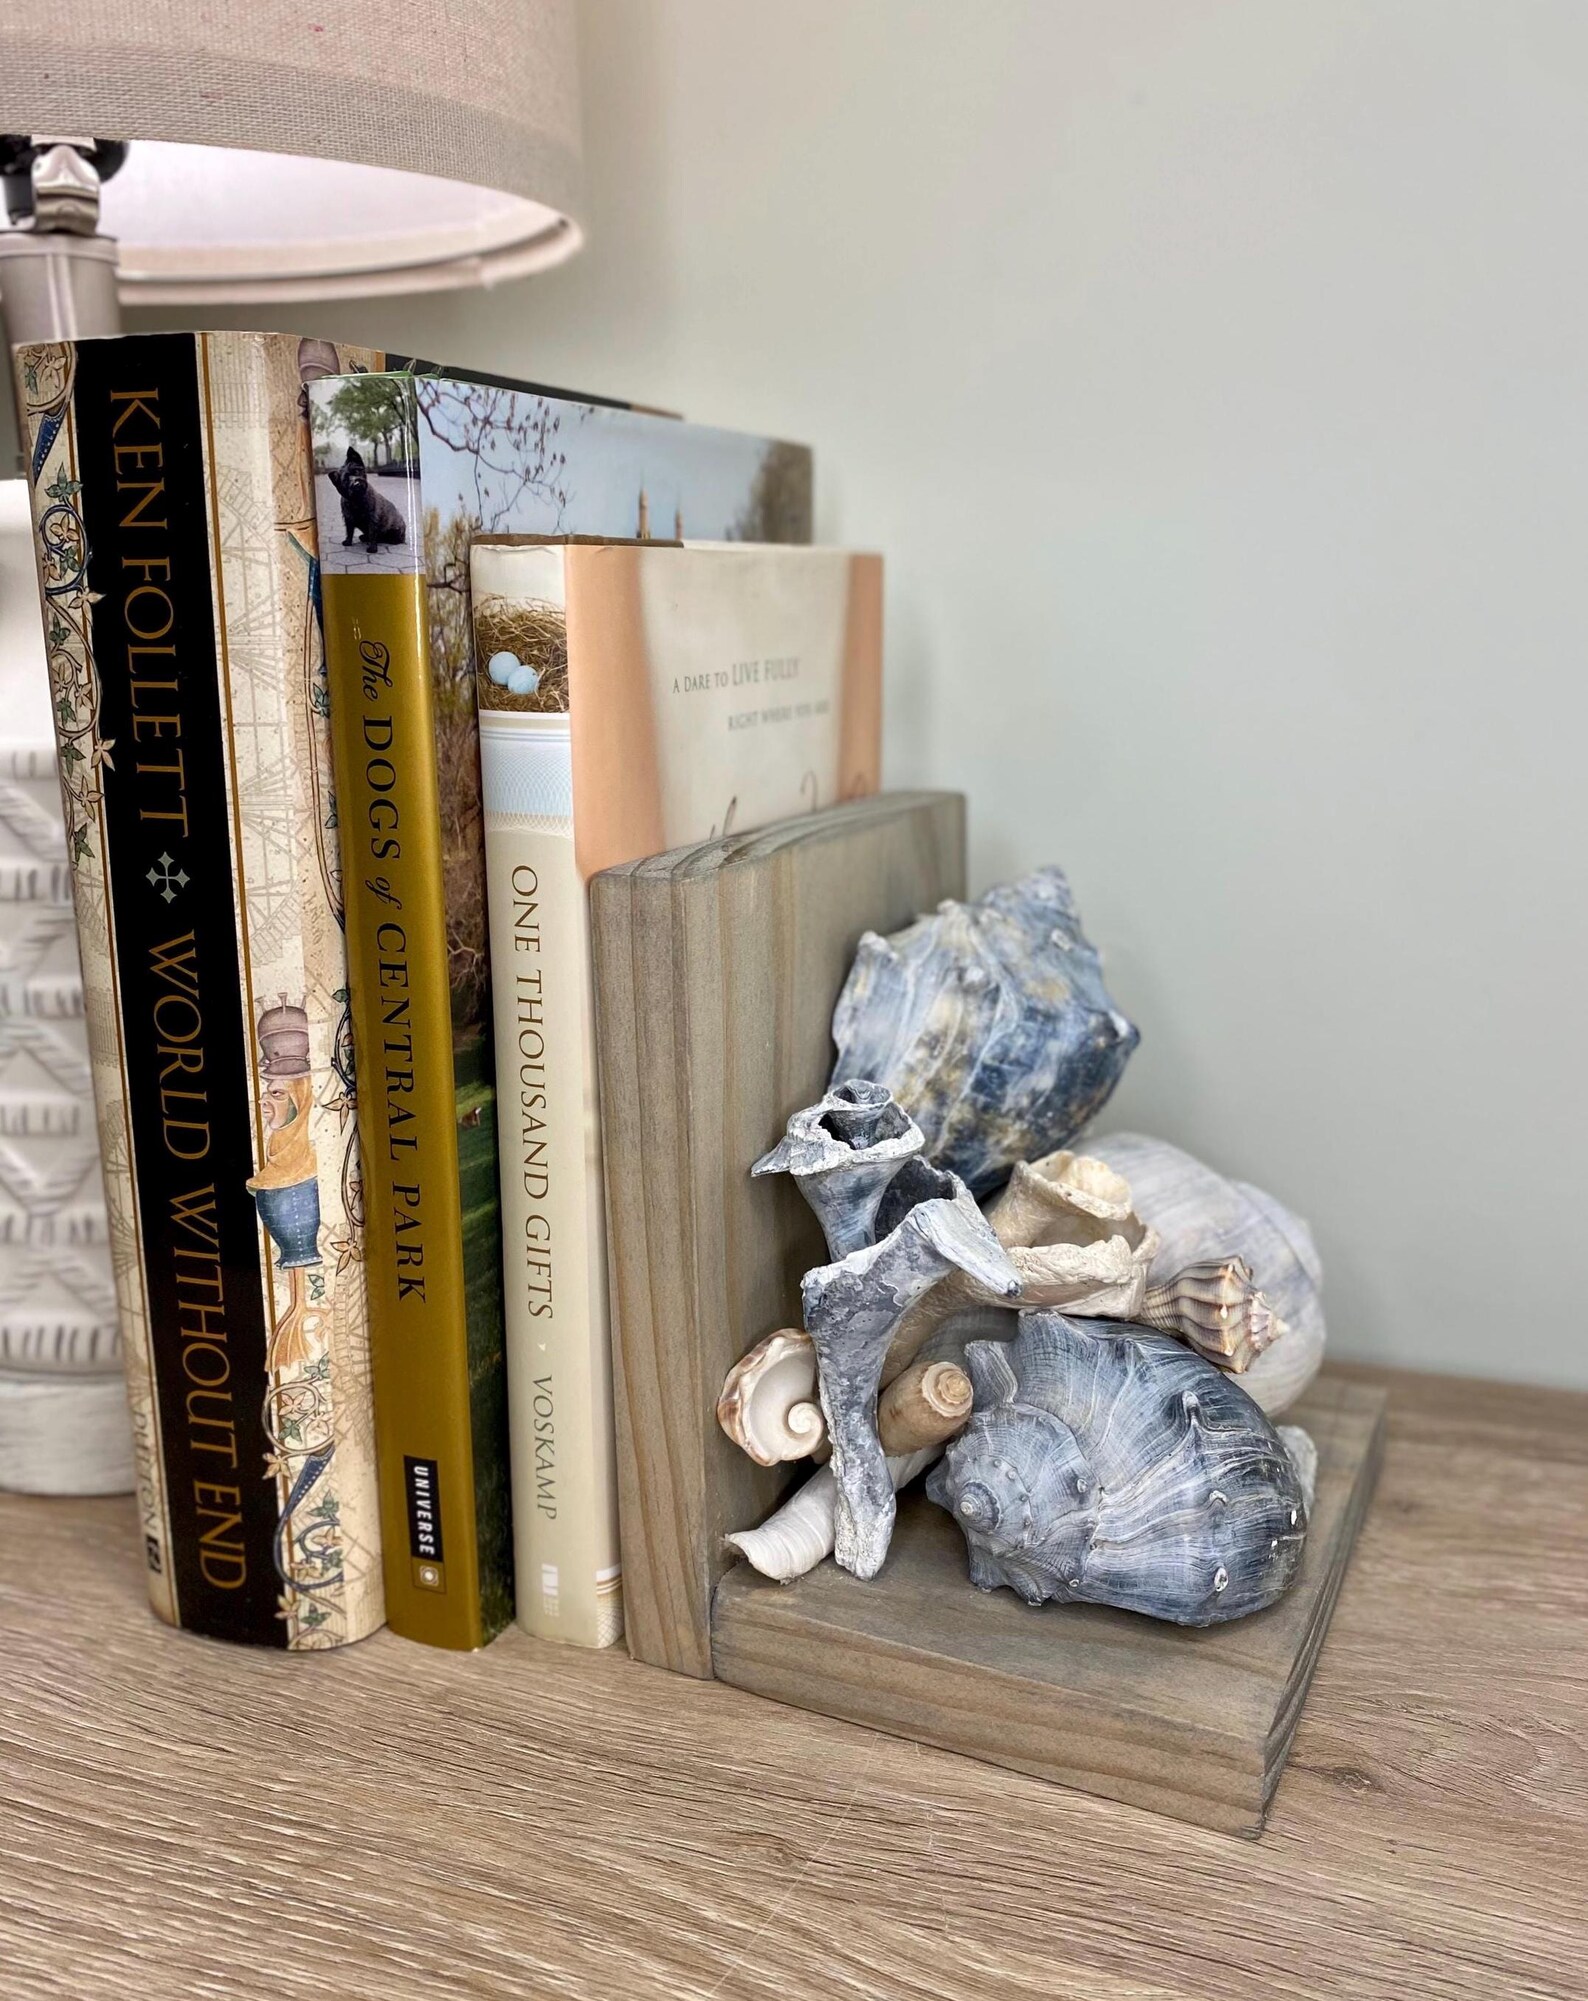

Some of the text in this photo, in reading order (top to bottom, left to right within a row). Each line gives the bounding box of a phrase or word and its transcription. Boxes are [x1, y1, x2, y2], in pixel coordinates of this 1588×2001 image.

[110, 387, 188, 838] KEN FOLLETT
[673, 678, 680, 694] A
[684, 673, 711, 693] DARE
[713, 670, 729, 688] TO
[732, 661, 759, 686] LIVE
[359, 640, 426, 1302] The DOGS of CENTRAL PARK
[511, 865, 553, 1319] ONE THOUSAND GIFTS
[149, 929, 246, 1590] WORLD WITHOUT END
[532, 1374, 557, 1521] VOSKAMP
[414, 1466, 435, 1556] UNIVERSE
